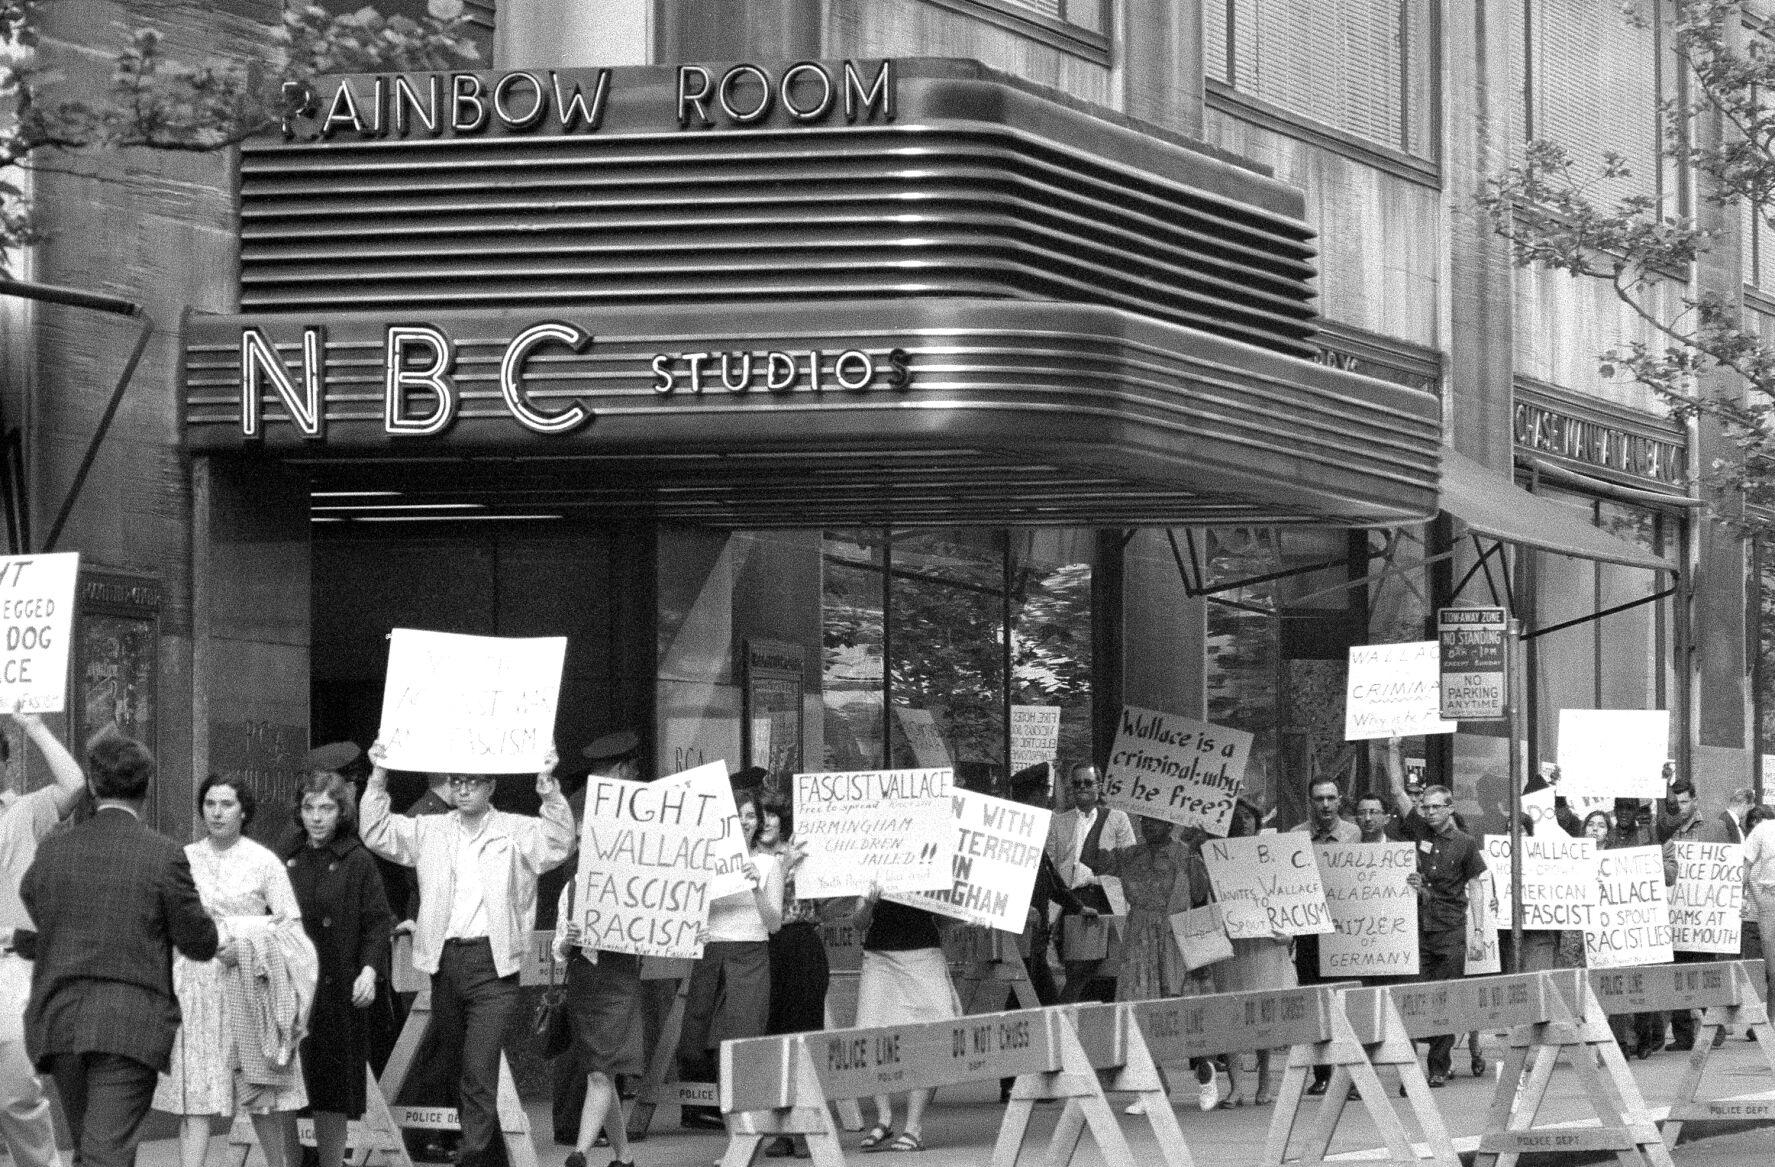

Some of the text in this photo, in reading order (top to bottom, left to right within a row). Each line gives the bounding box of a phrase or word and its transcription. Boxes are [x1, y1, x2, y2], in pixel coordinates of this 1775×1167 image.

[281, 60, 893, 136] RAINBOW ROOM
[241, 321, 912, 439] NBC STUDIOS
[3, 598, 55, 619] EGGED
[1481, 611, 1501, 623] ZONE
[6, 625, 52, 651] DOG
[1443, 631, 1501, 645] NO STANDING
[1351, 646, 1440, 664] WALLAC
[1352, 680, 1440, 700] CRIMINA
[1464, 675, 1482, 686] NO
[1448, 687, 1499, 699] PARKING
[1448, 700, 1499, 708] ANYTIME
[1122, 709, 1235, 758] Wallace is a
[798, 770, 951, 802] FASCIST WALLACE
[595, 782, 717, 826] FIGHT
[1107, 773, 1233, 824] is he free?
[798, 818, 913, 836] BIRMINGHAM
[983, 802, 1035, 838] WITH
[591, 826, 716, 871] WALLACE
[825, 837, 905, 852] CHILDREN
[958, 827, 1041, 870] TERROR
[1489, 839, 1590, 860] GO WALLACE
[1677, 844, 1732, 862] KE HIS
[952, 854, 973, 881] IN
[1322, 849, 1415, 869] WALLACE
[1357, 870, 1377, 882] OF
[1679, 863, 1745, 883] LICE DOGS
[585, 871, 707, 912] FASCISM
[1326, 885, 1411, 900] ALABAMA
[1599, 880, 1662, 906] ALLACE
[1266, 902, 1331, 930] RACISM
[1522, 904, 1595, 925] FASCIST
[1617, 907, 1657, 926] SPOUT
[1669, 909, 1727, 926] OAMS AT
[584, 909, 702, 947] RACISM
[1672, 928, 1738, 945] HE MOUTH
[1360, 937, 1377, 947] OF
[1586, 924, 1673, 953] RACIST LIES
[1329, 951, 1411, 967] GERMANY
[828, 1020, 1030, 1071] POLICE LINE DO NOT CROSS
[679, 1088, 714, 1100] POLICE
[405, 1111, 443, 1123] POLICE
[1709, 1105, 1769, 1115] POLICE DEPT
[1516, 1135, 1580, 1146] POLICE DEPT
